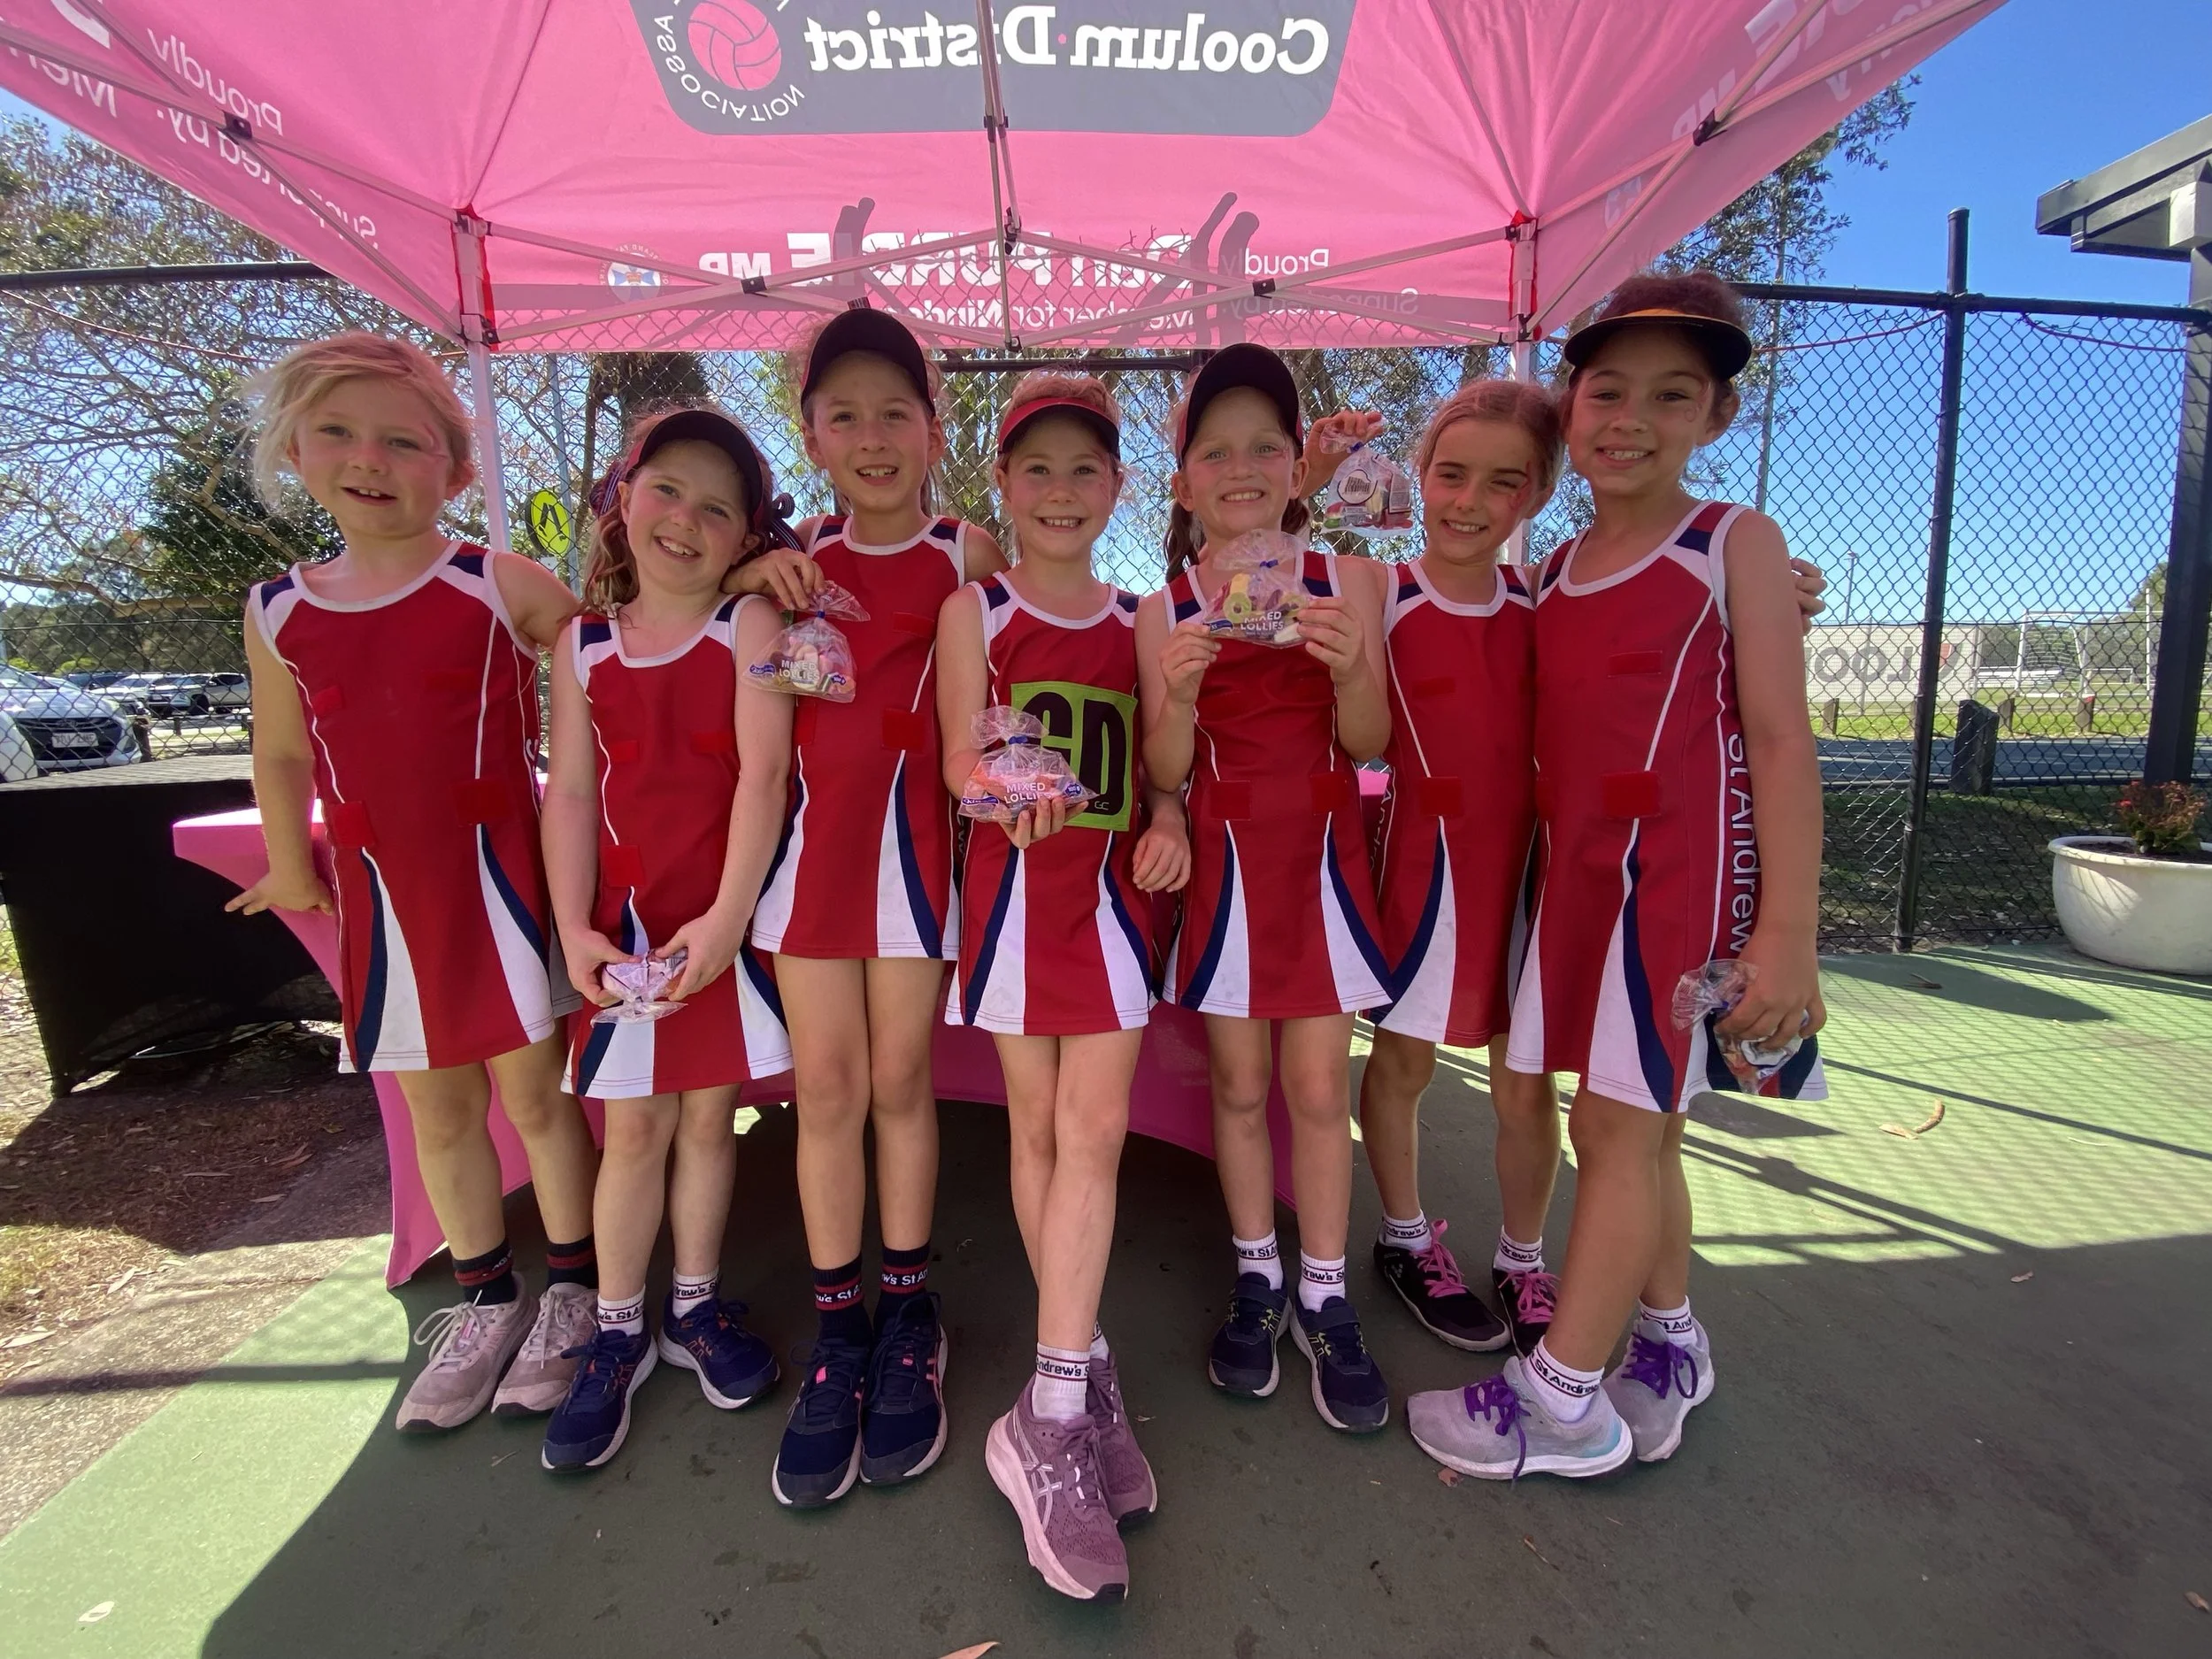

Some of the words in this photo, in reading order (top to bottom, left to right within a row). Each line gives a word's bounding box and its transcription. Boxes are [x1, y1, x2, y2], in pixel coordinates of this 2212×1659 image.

[1240, 619, 1285, 632] LOLLIES
[780, 659, 818, 671] MIXED
[779, 667, 820, 680] LOLLIES
[1006, 782, 1046, 794] MIXED
[901, 1275, 916, 1286] St
[616, 1311, 632, 1321] St
